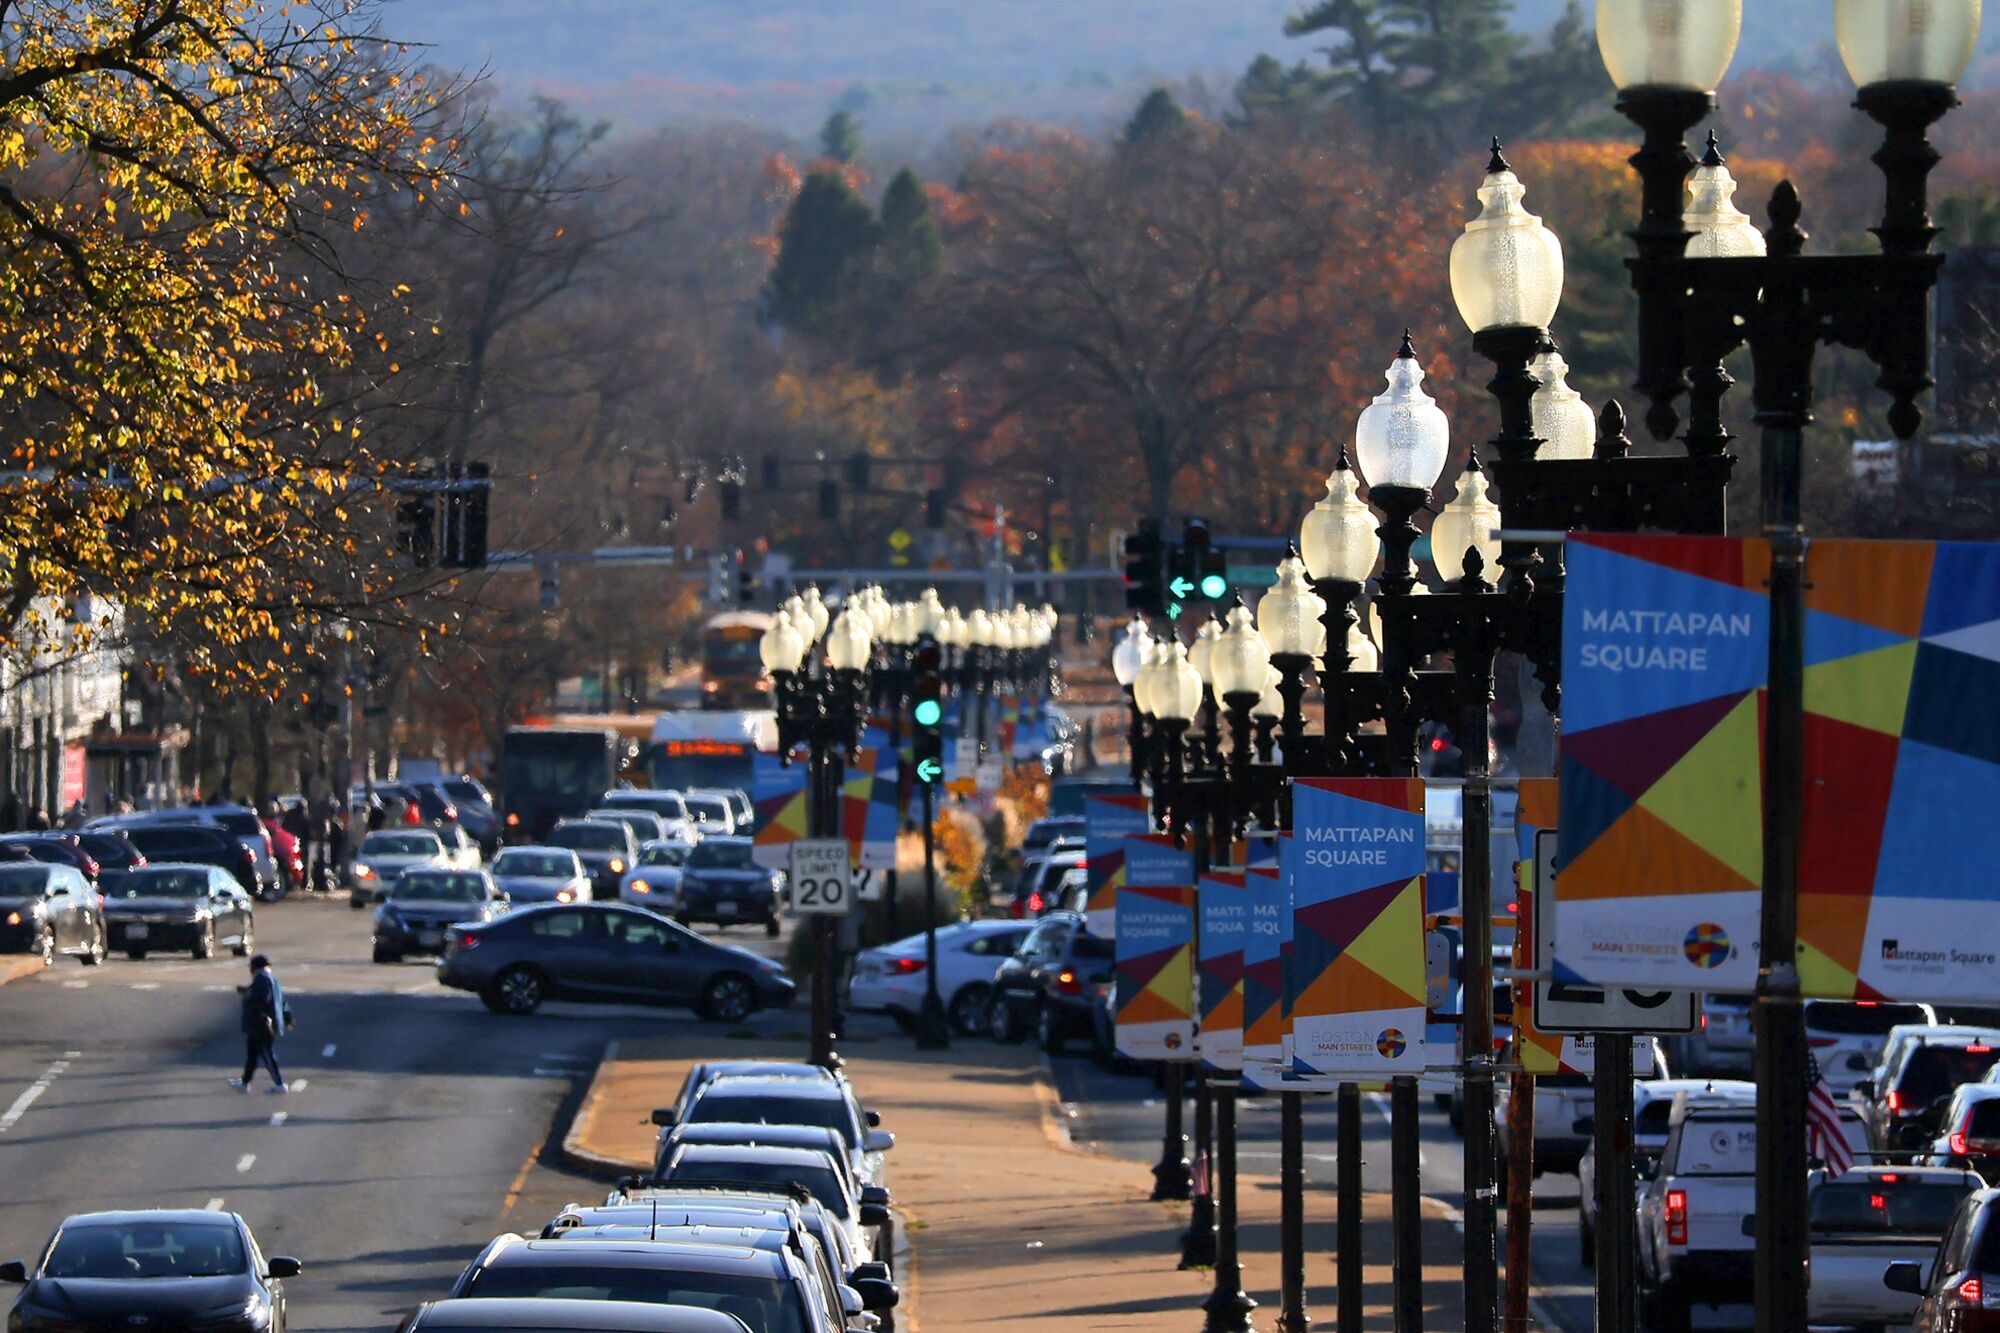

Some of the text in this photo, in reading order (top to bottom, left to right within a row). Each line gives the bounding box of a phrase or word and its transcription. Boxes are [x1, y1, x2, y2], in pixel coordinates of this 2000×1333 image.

[1583, 609, 1750, 637] MATTAPAN
[1581, 644, 1707, 671] SQUARE
[1305, 827, 1414, 842] MATTAPAN
[797, 847, 845, 860] SPEED
[1305, 850, 1387, 867] SQUARE
[800, 863, 838, 875] LIMIT
[800, 878, 843, 905] 20
[1207, 906, 1246, 917] MATT
[1207, 921, 1245, 934] SQUA
[1592, 942, 1623, 952] MAIN
[1882, 940, 1996, 966] Mattapan Square
[1312, 1030, 1374, 1043] BOSTON
[1318, 1043, 1374, 1051] MAIN STREETS
